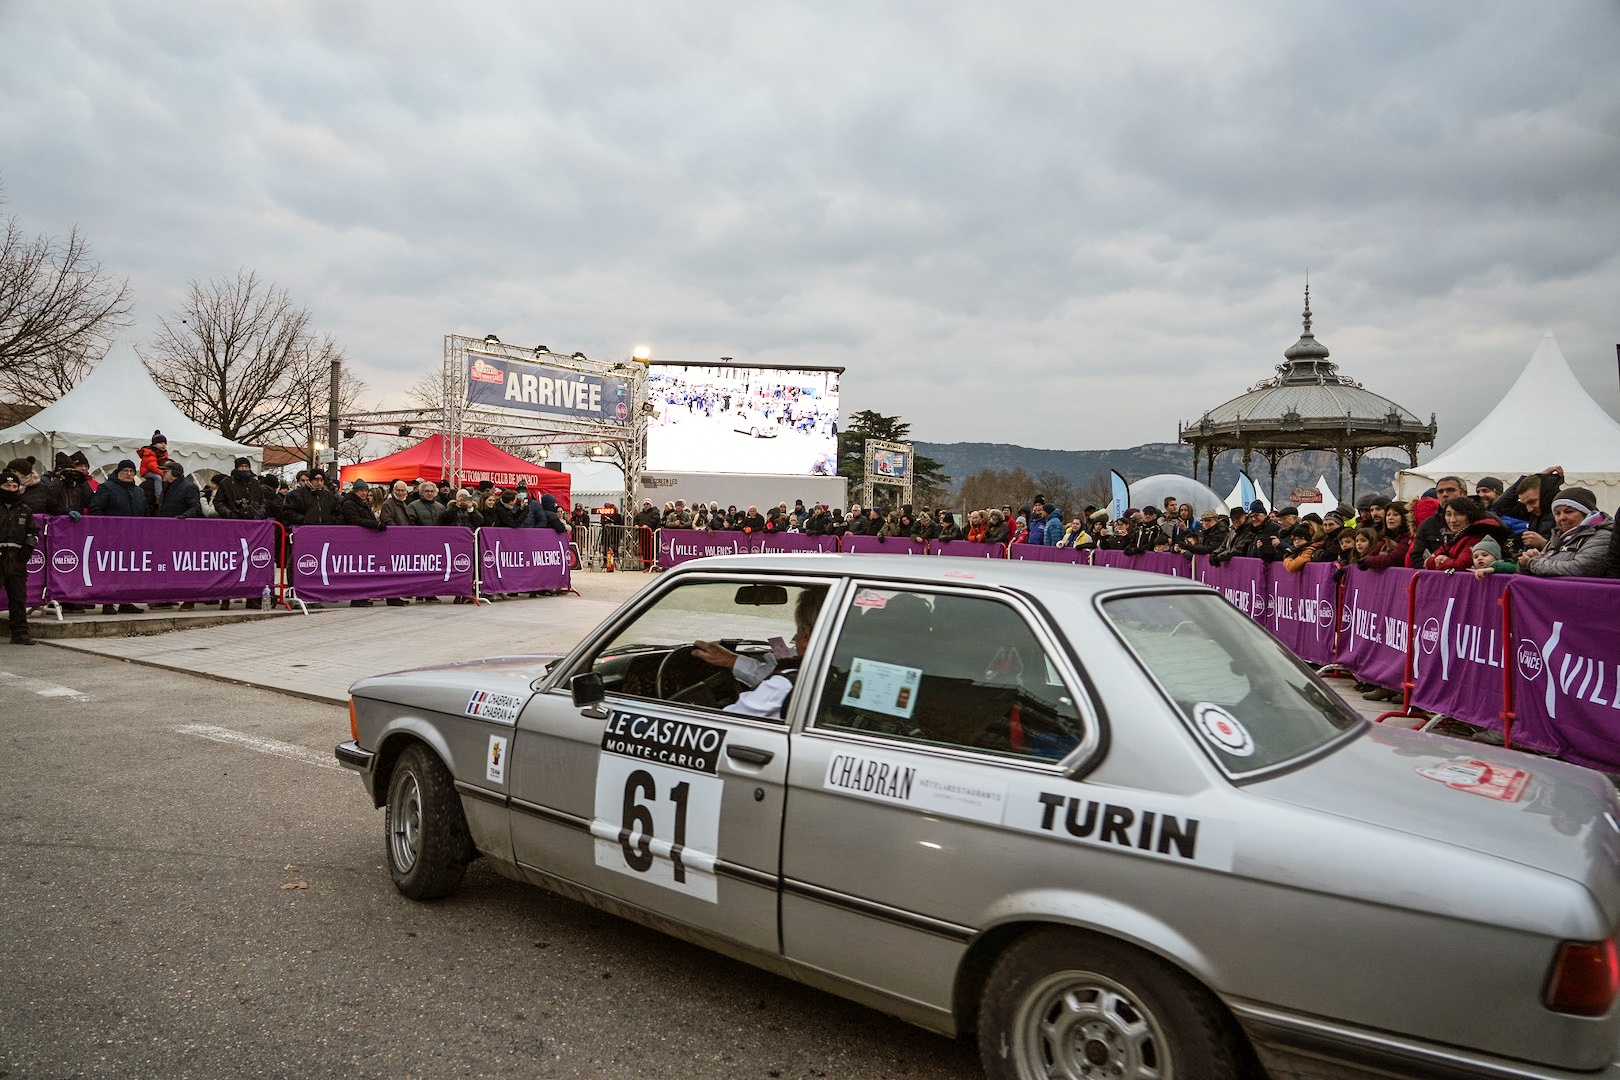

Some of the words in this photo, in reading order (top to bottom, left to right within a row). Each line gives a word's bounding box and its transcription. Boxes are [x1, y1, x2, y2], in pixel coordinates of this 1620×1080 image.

[504, 371, 601, 412] ARRIVÉE
[494, 473, 508, 484] CLUB
[509, 474, 515, 485] DE
[516, 474, 538, 486] MONACO
[96, 551, 152, 571] VILLE
[172, 551, 237, 571] VALENCE
[501, 552, 524, 567] VILLE
[532, 551, 560, 566] VALENCE
[676, 545, 697, 555] VILLE
[705, 546, 732, 556] VALENCE
[332, 555, 375, 573] VILLE
[391, 554, 442, 572] VALENCE
[1278, 596, 1293, 619] VILLE
[1356, 608, 1377, 642] VILLE
[1456, 623, 1504, 668] VILL
[488, 693, 512, 707] CHABRAN
[483, 705, 507, 719] CHABRAN
[605, 712, 631, 735] LE
[631, 717, 719, 753] CASINO
[830, 755, 917, 800] CHABRAN
[618, 769, 690, 884] 61
[1038, 792, 1199, 859] TURIN
